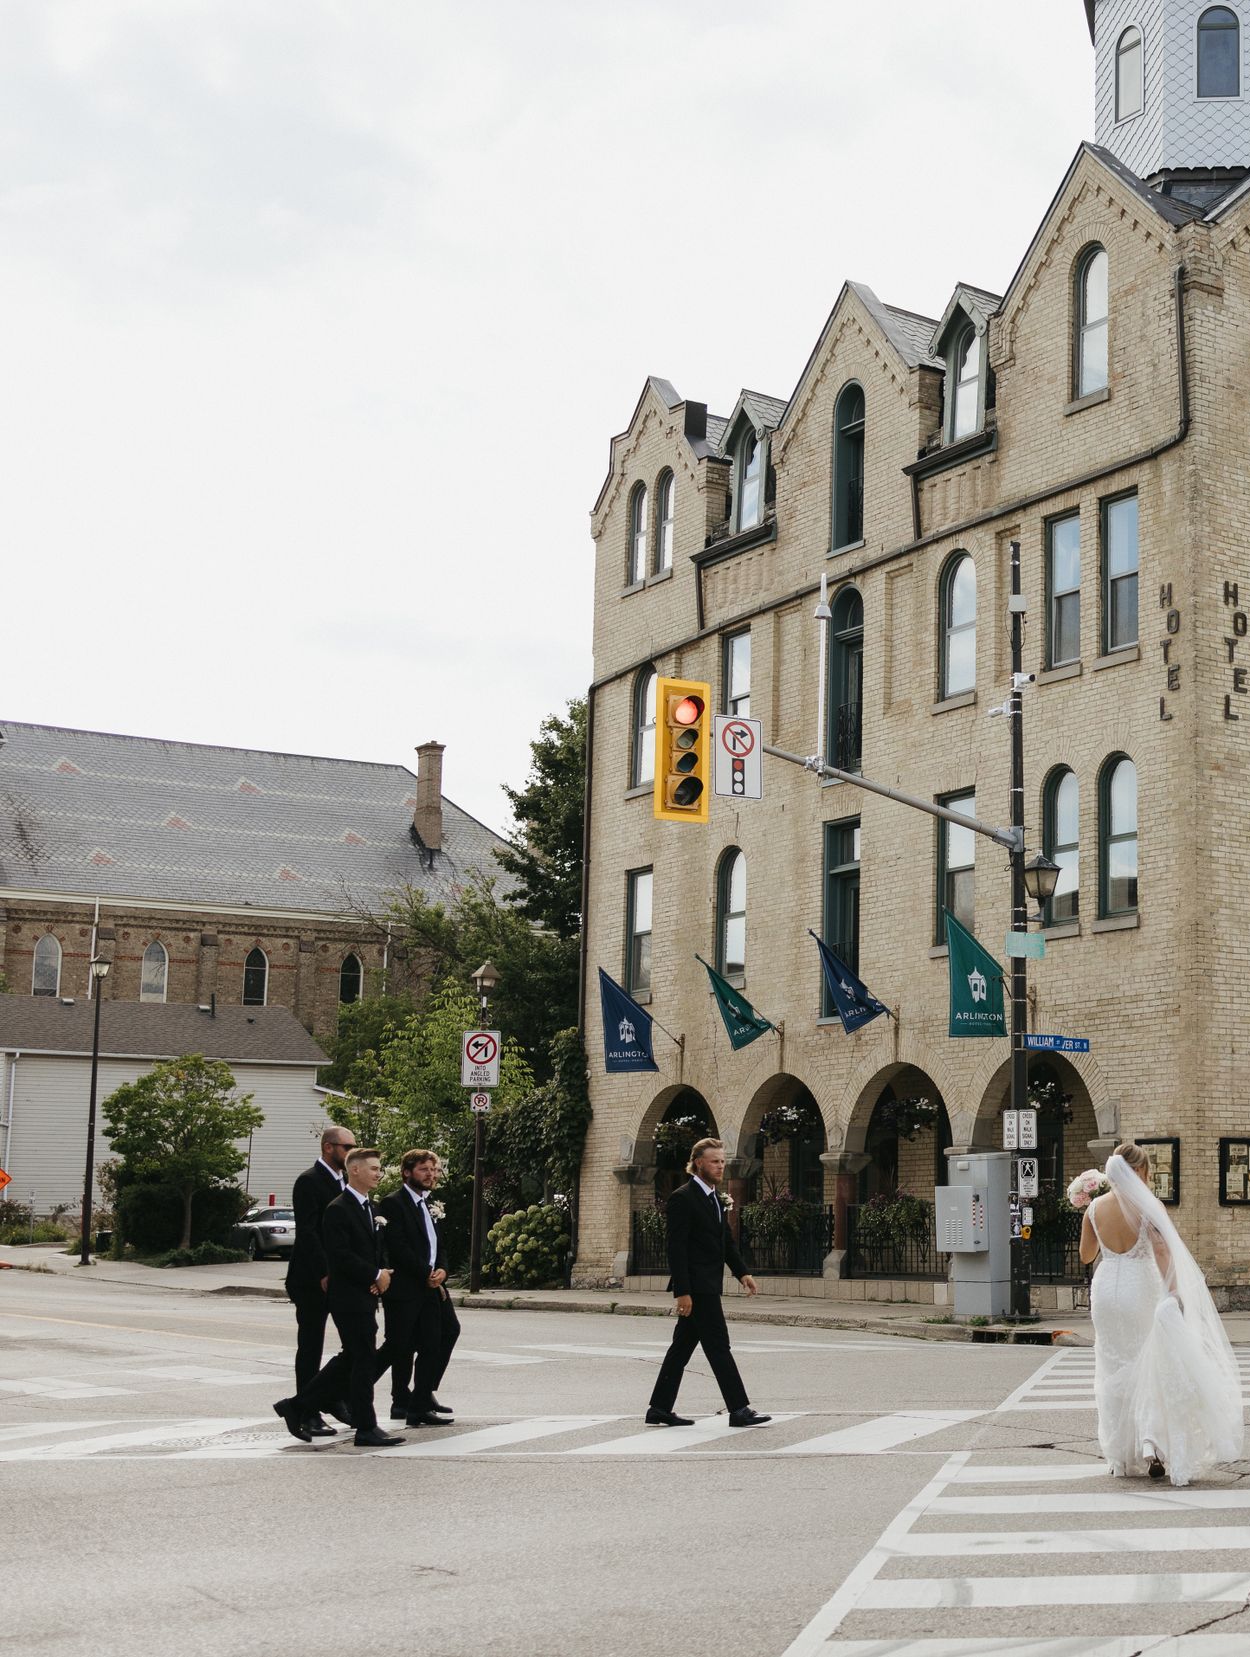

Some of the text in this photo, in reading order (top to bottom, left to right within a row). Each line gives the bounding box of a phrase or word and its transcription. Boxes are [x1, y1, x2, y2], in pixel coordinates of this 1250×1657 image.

[1159, 582, 1180, 721] HOTEL
[1223, 580, 1248, 721] HOTEL
[1027, 1036, 1054, 1047] WILLIAM
